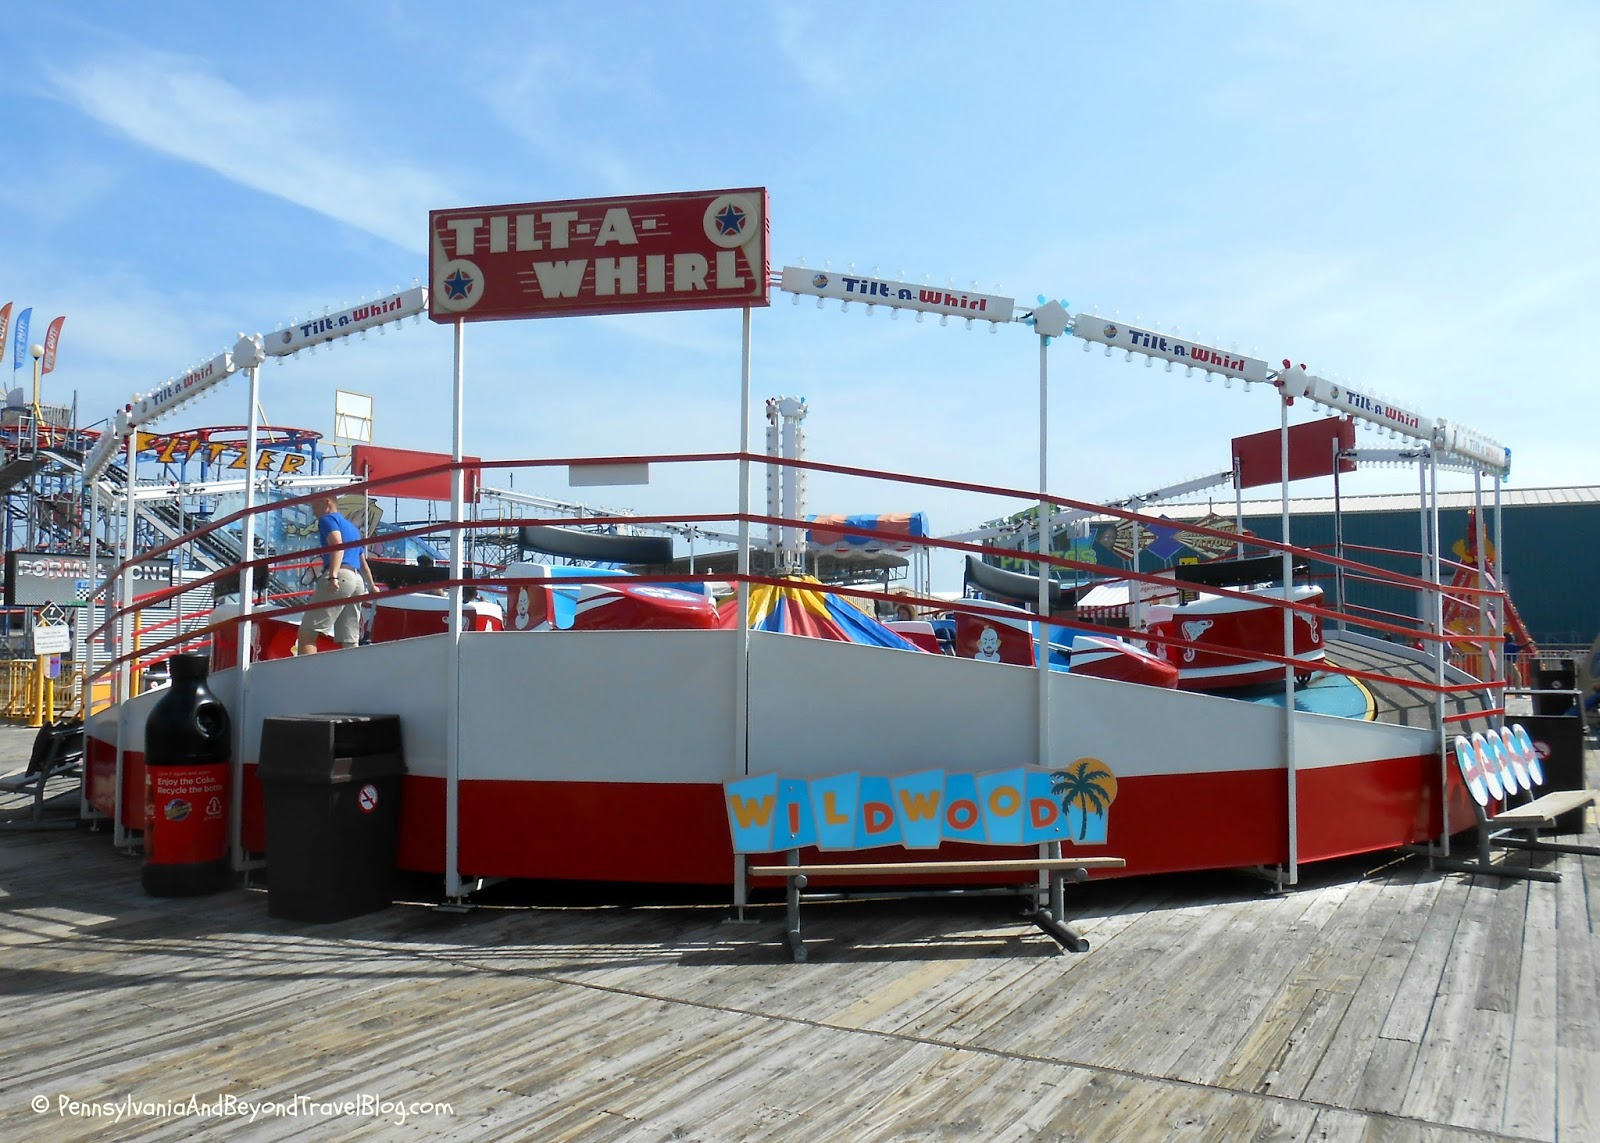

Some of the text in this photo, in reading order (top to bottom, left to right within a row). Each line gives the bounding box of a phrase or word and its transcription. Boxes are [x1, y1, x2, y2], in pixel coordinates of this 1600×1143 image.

[532, 251, 746, 299] WHIRL
[47, 327, 58, 348] OUT!
[136, 431, 307, 474] FLITZER
[1124, 539, 1144, 548] AT
[18, 560, 170, 581] FORMUL ONE
[49, 606, 56, 616] 7
[158, 778, 178, 787] Enjoy
[158, 787, 187, 795] Recycle
[730, 785, 1059, 834] WILDWOOD
